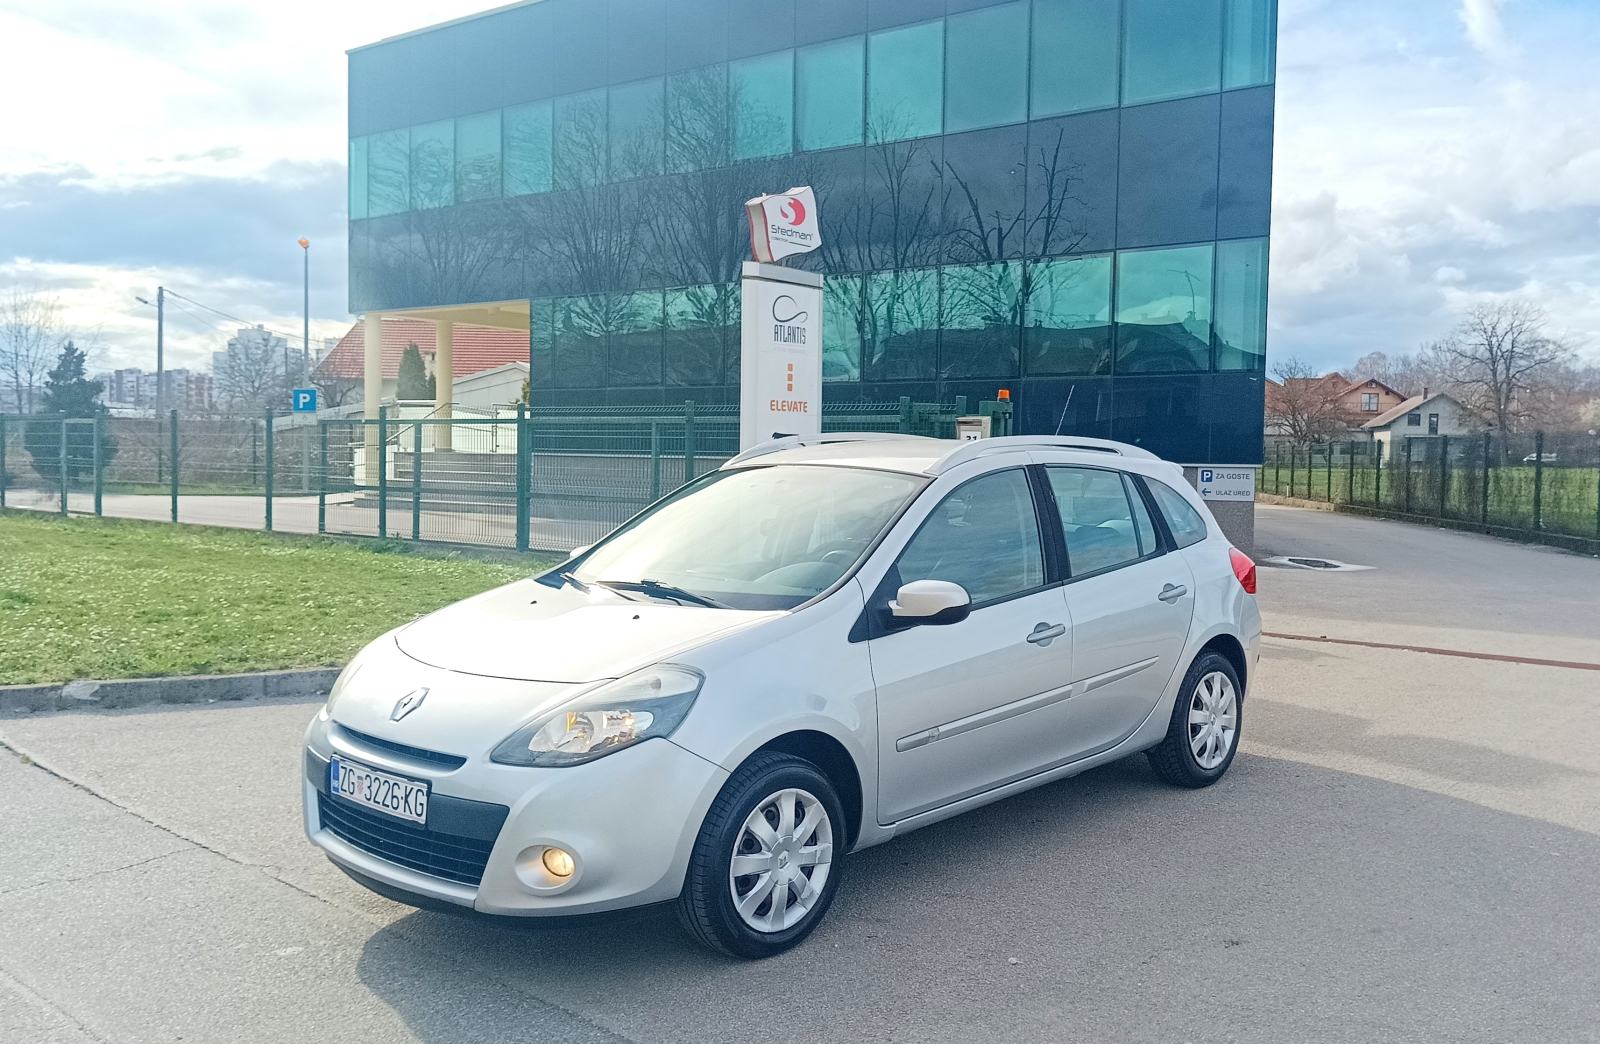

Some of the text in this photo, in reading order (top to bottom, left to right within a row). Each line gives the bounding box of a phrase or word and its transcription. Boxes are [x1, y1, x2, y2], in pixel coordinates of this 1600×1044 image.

[771, 225, 813, 241] Stedman
[774, 324, 806, 344] ATLANTIS
[299, 393, 310, 408] P
[770, 400, 808, 413] ELEVATE
[1203, 471, 1211, 482] P
[340, 765, 355, 795] ZG
